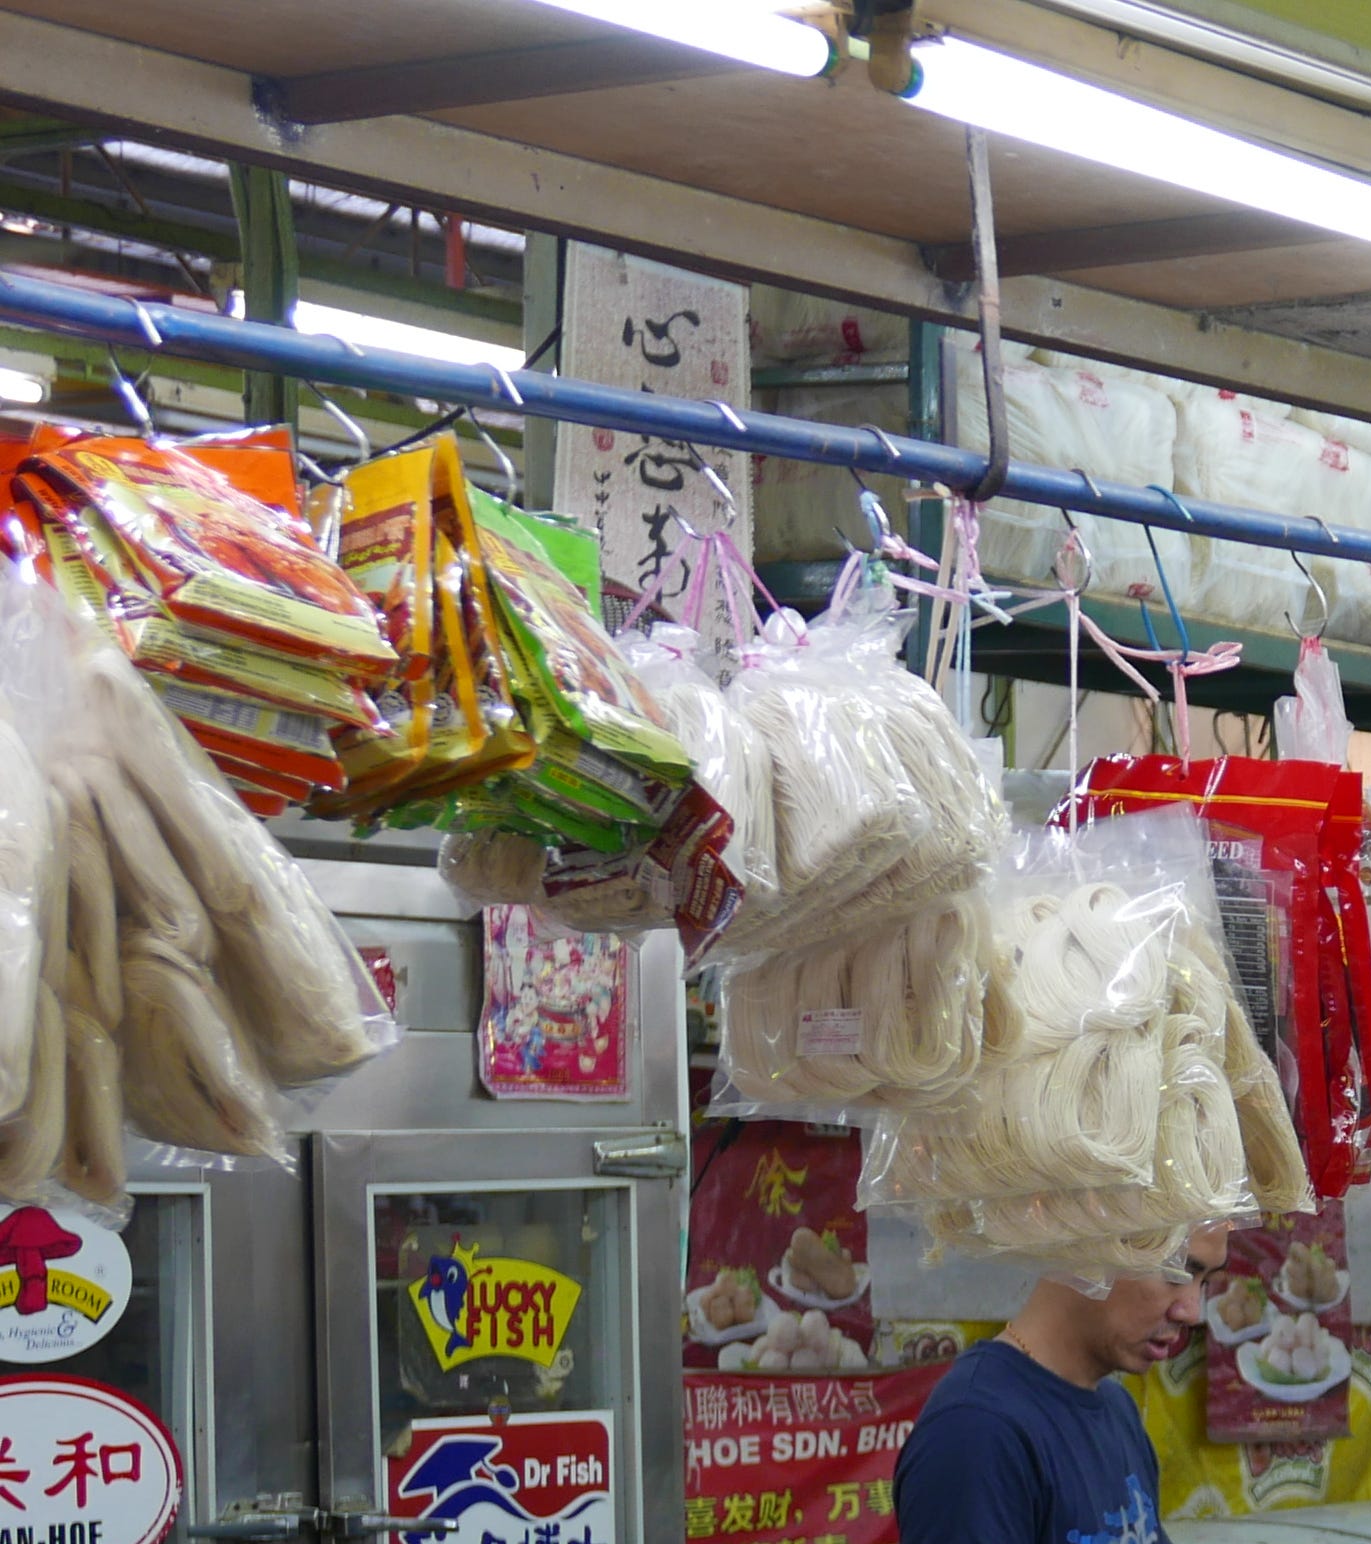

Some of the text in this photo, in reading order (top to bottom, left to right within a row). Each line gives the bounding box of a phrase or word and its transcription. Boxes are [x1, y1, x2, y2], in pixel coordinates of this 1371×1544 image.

[51, 1278, 103, 1312] ROOM
[467, 1281, 557, 1315] LUCKY
[467, 1311, 556, 1349] FISH
[772, 1428, 848, 1462] SDN.
[524, 1455, 603, 1488] Dr Fish
